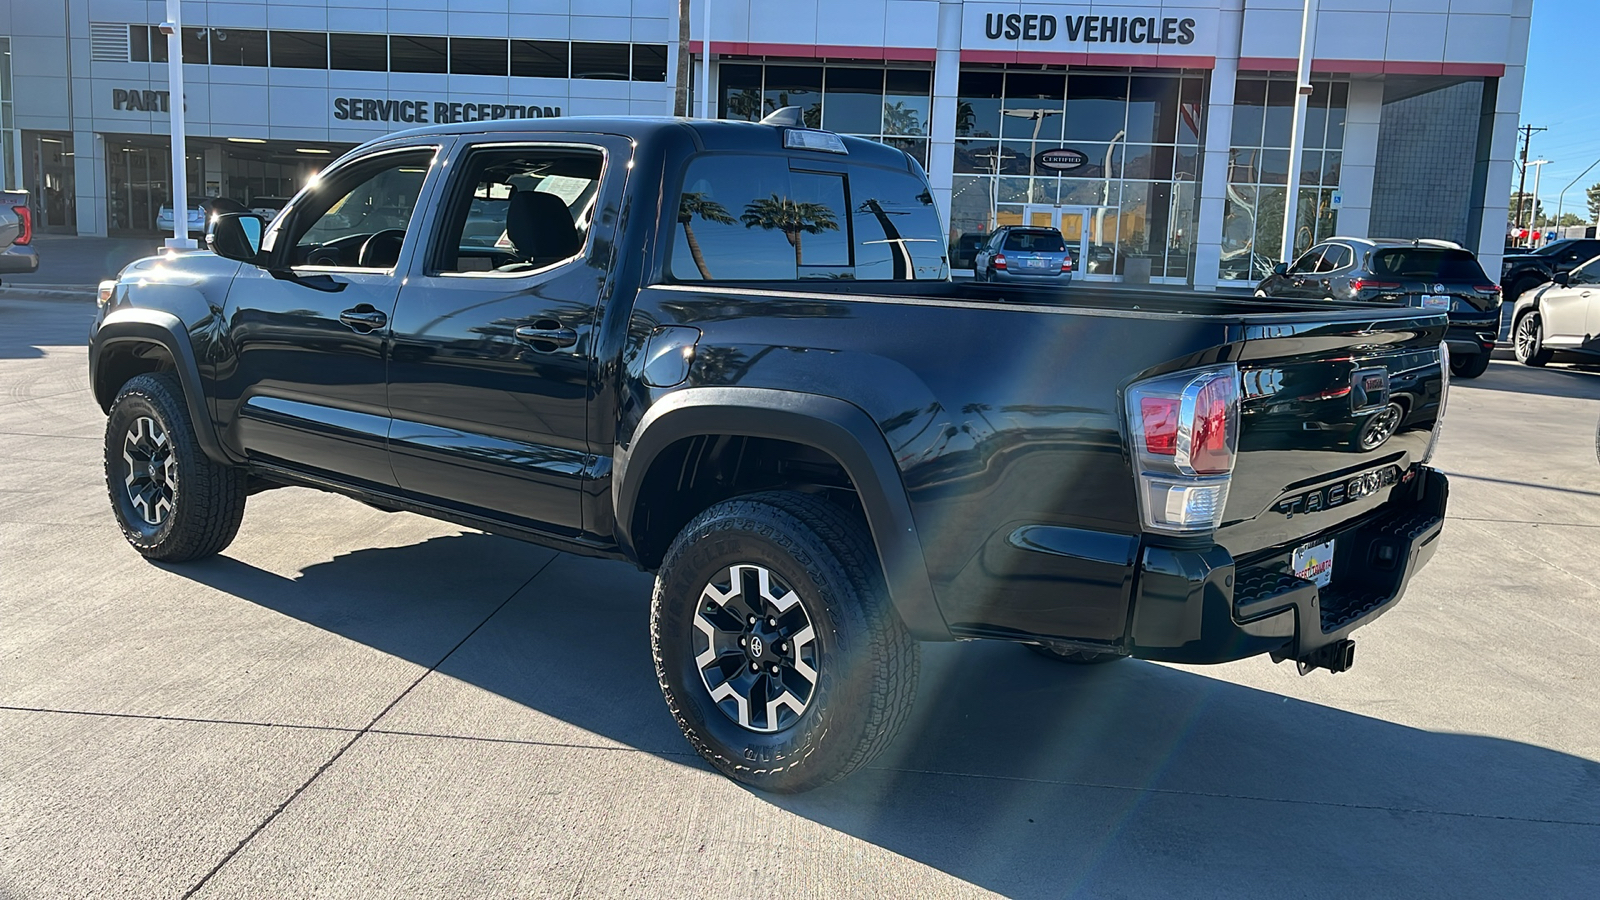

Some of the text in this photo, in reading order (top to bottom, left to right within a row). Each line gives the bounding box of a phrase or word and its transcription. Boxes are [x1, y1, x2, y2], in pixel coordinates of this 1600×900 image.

[986, 13, 1196, 45] USED VEHICLES
[112, 88, 187, 113] PART
[334, 97, 561, 123] SERVICE RECEPTION
[1280, 466, 1397, 519] TACOMA
